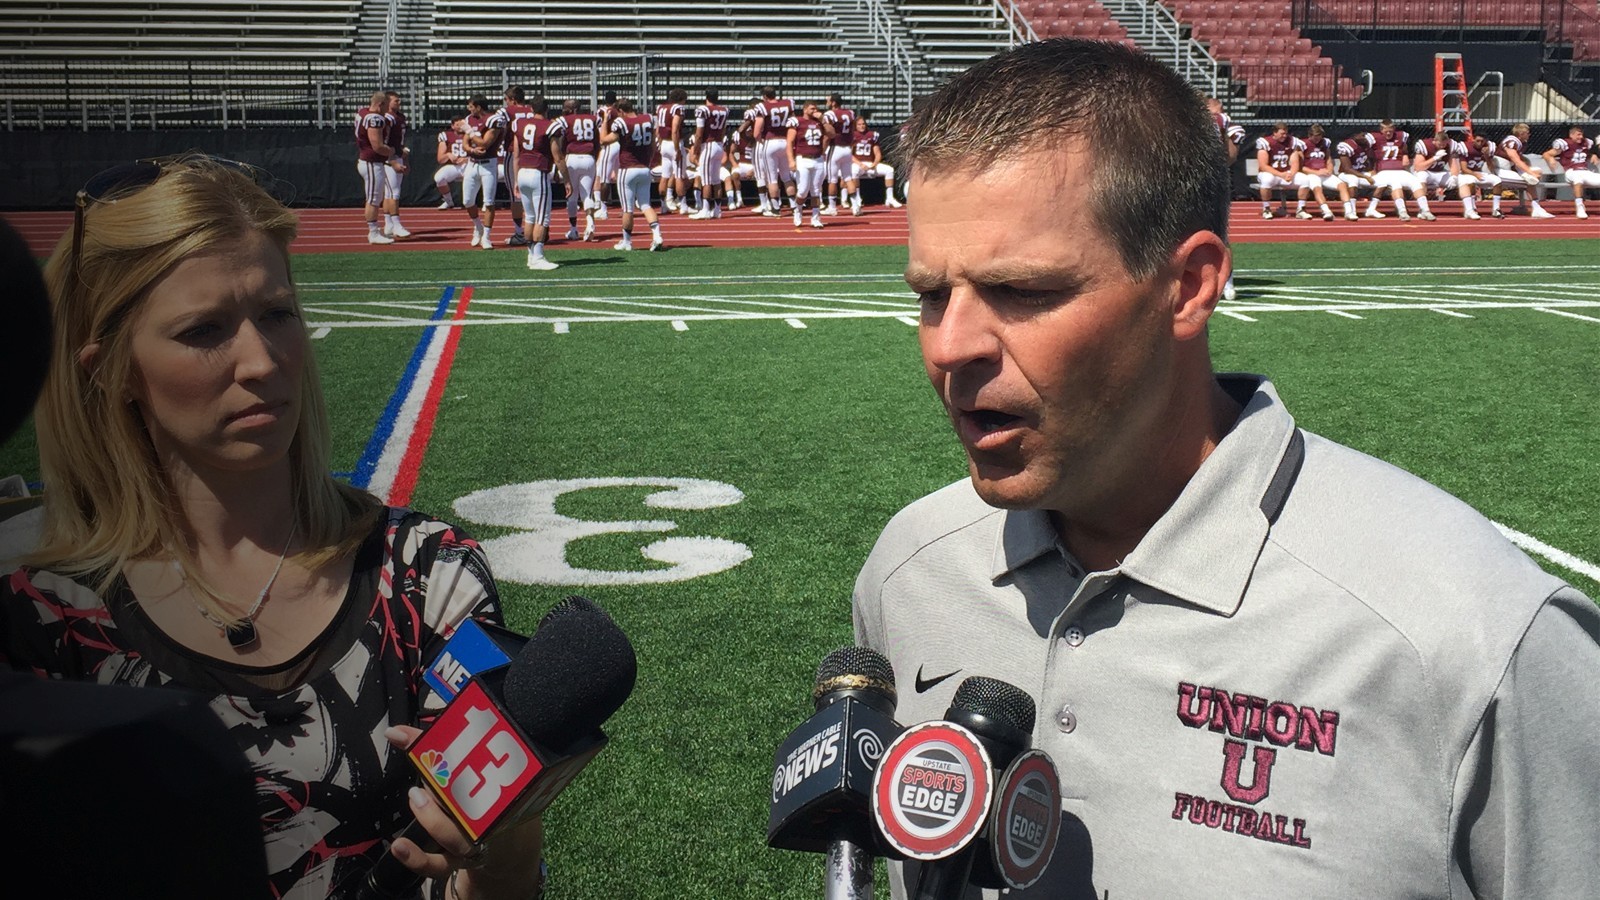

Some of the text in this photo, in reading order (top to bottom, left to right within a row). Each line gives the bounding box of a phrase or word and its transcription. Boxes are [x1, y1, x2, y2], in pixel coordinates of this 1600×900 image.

[573, 118, 594, 141] 48
[710, 110, 727, 130] 37
[770, 106, 789, 128] 67
[522, 123, 536, 150] 9
[631, 122, 652, 146] 46
[804, 129, 822, 146] 42
[1382, 146, 1399, 160] 77
[1177, 681, 1339, 757] UNION
[442, 706, 529, 821] 13
[782, 732, 841, 797] NEWS
[922, 759, 951, 771] UPSTATE
[1220, 738, 1277, 805] U
[902, 767, 965, 793] SPORTS
[901, 785, 958, 815] EDGE
[1011, 814, 1043, 846] EDGE
[1172, 792, 1311, 849] FOOTBALL
